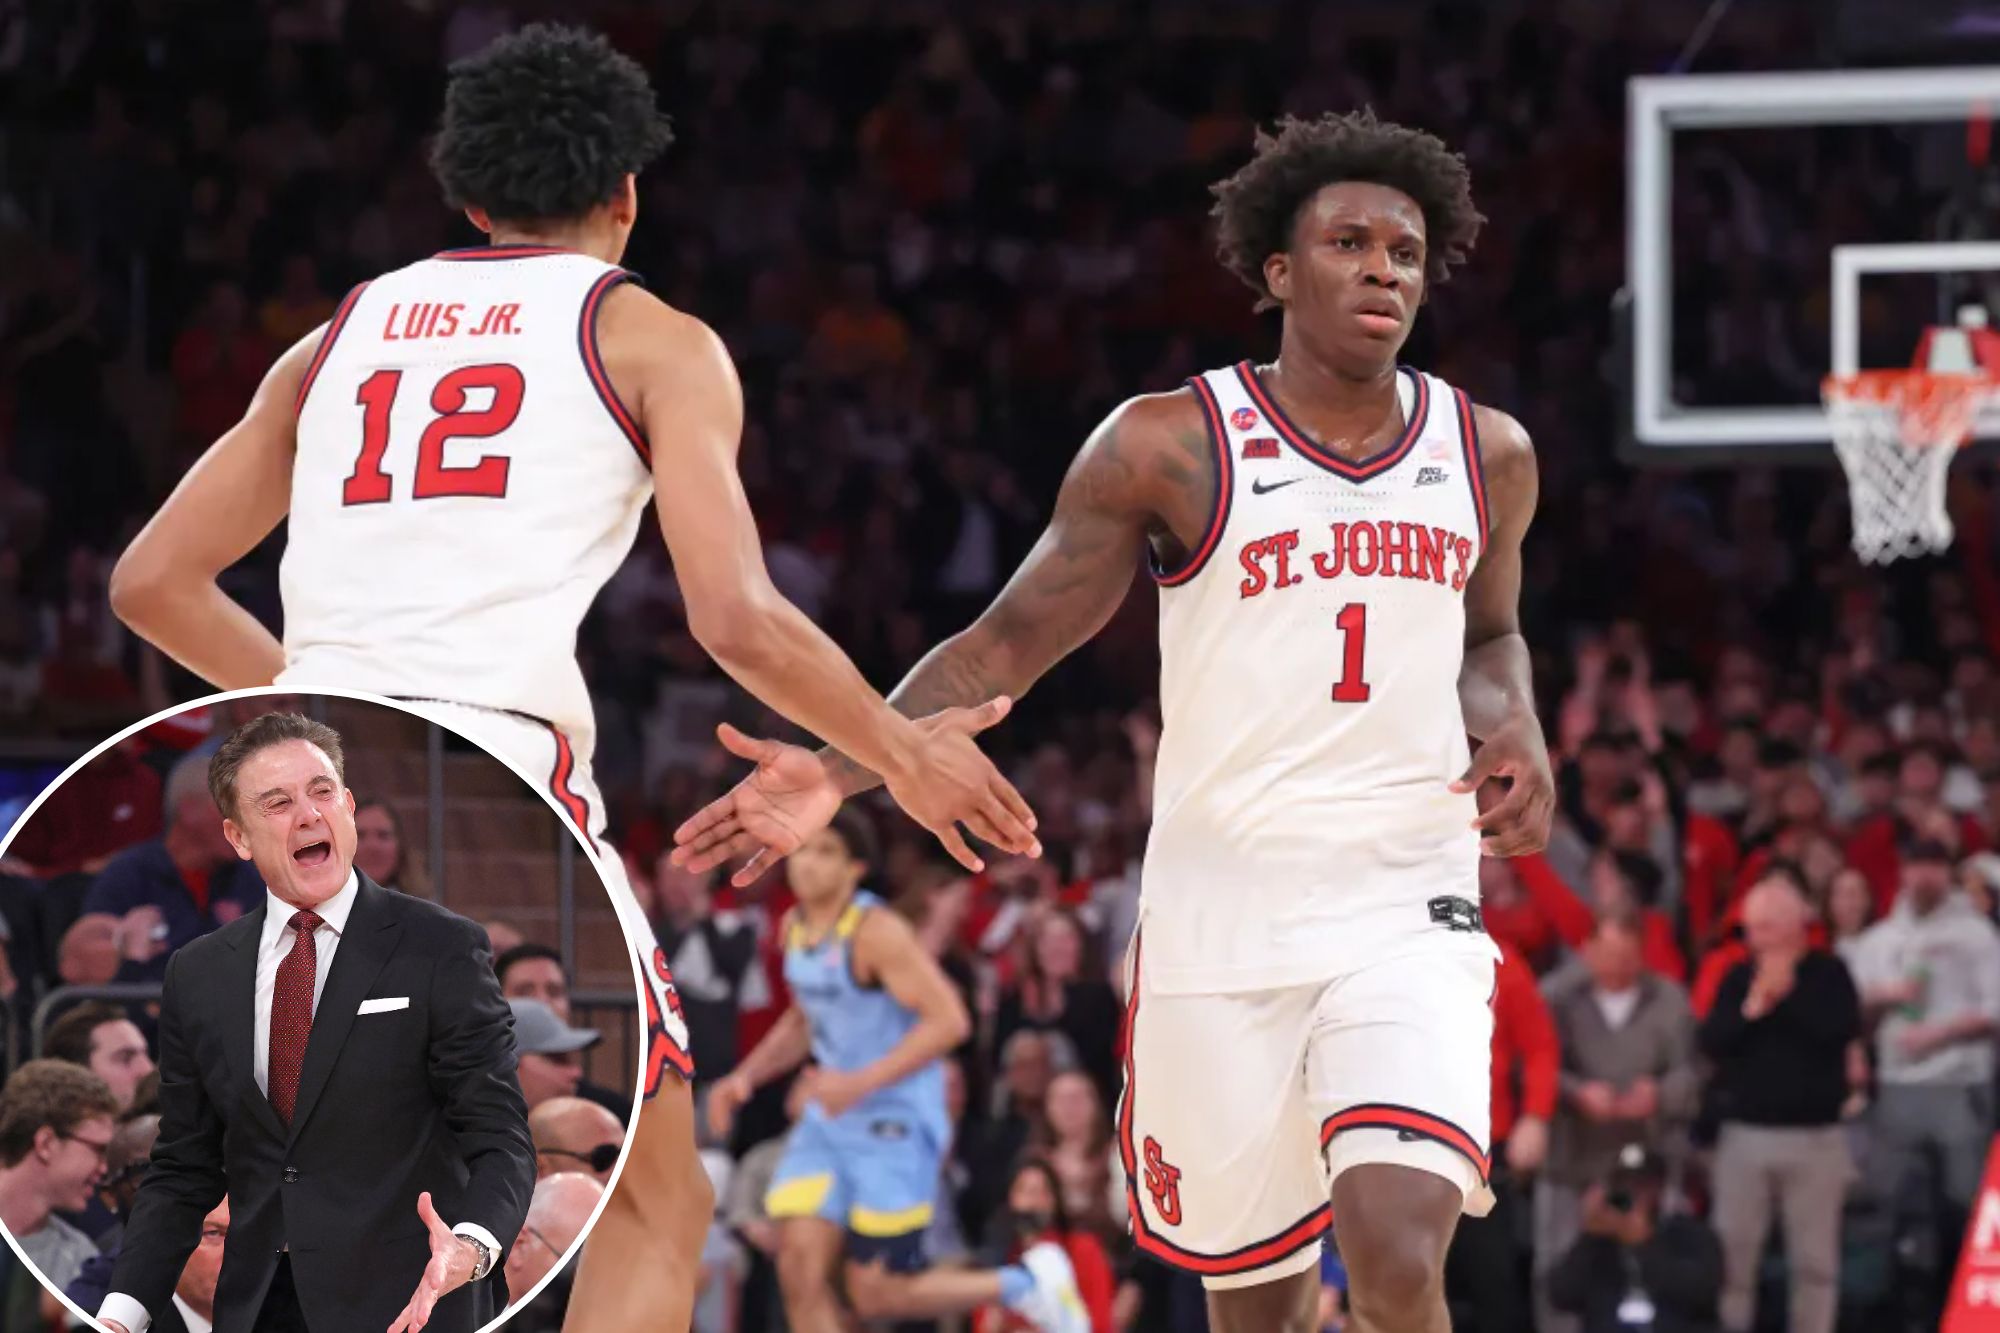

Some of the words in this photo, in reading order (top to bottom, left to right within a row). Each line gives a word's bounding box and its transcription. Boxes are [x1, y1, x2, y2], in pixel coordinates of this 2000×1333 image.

[383, 303, 465, 340] LUIS
[468, 303, 522, 335] JR.
[341, 363, 526, 506] 12
[1415, 474, 1450, 485] EAST
[1239, 529, 1303, 599] ST.
[1310, 521, 1472, 592] JOHN'S
[1331, 603, 1370, 702] 1
